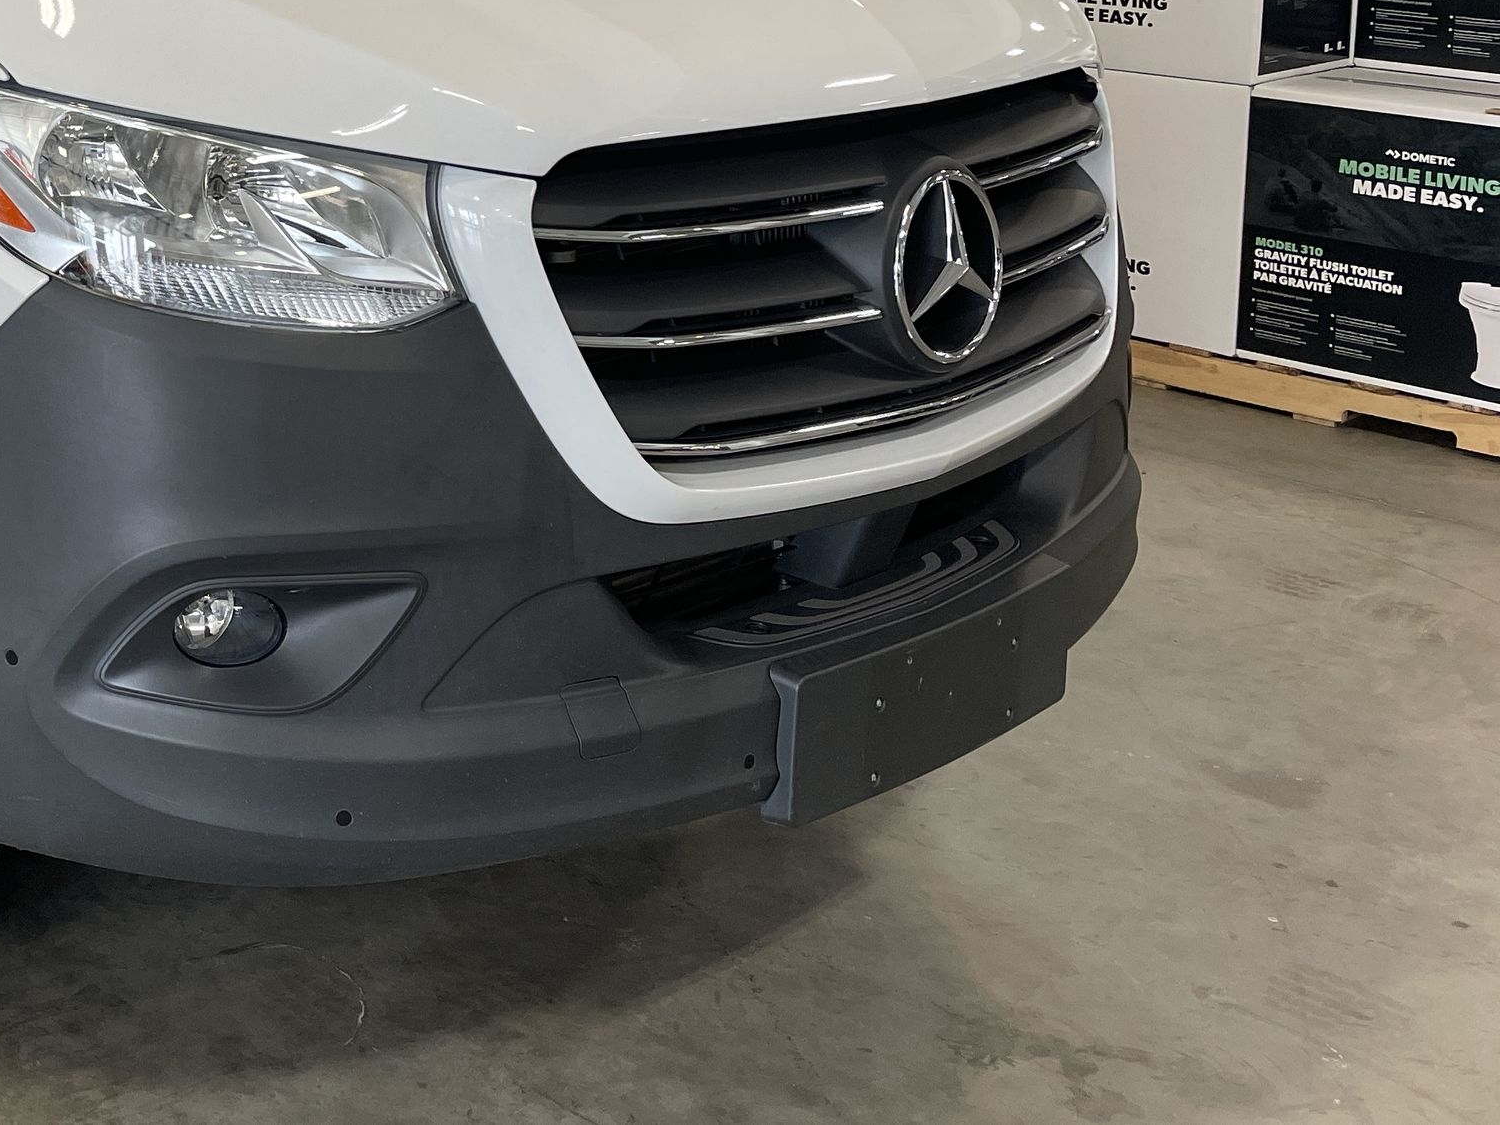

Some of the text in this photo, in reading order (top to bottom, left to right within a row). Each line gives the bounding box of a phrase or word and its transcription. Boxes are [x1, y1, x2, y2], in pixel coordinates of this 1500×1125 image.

[1099, 8, 1153, 27] EASY.
[1401, 151, 1456, 167] DOMETIC
[1338, 158, 1500, 196] MOBILE LIVING
[1352, 179, 1485, 213] MADE EASY.
[1255, 236, 1324, 257] MODEL 310
[1253, 259, 1308, 279] TOILETTE
[1309, 267, 1319, 280] À
[1320, 270, 1403, 295] ÉVACUATION
[1254, 248, 1395, 282] GRAVITY FLUSH TOILET
[1253, 270, 1277, 285] PAR
[1278, 275, 1333, 295] GRAVITÉ
